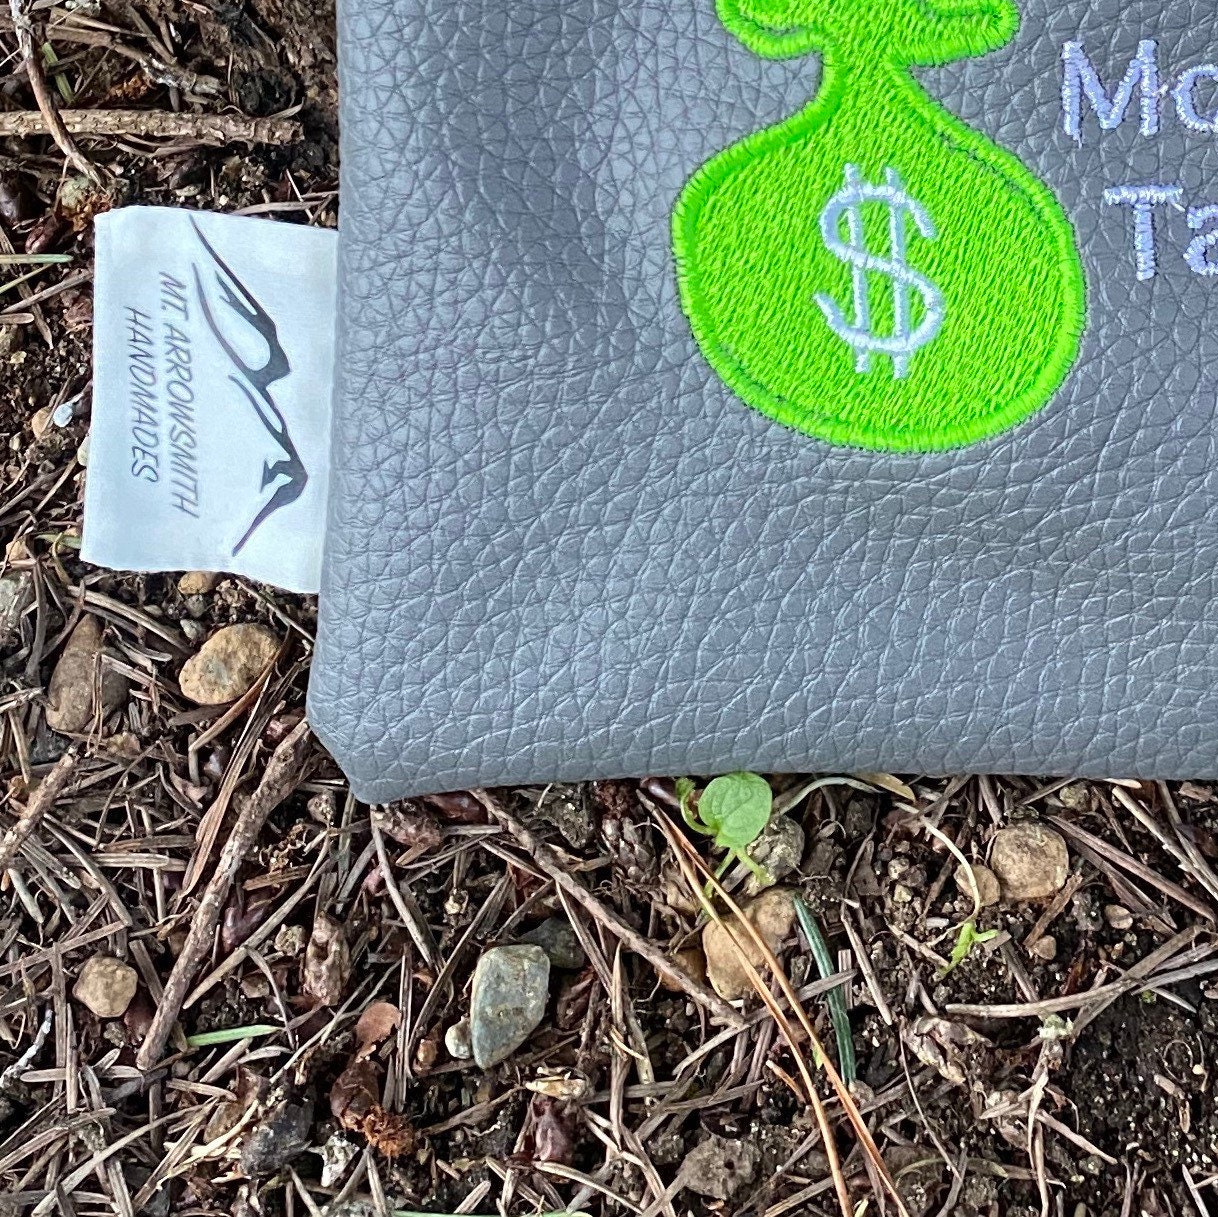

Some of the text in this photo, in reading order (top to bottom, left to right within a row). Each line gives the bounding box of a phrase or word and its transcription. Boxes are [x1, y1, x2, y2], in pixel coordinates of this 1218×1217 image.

[124, 305, 161, 484] HANDMADES
[159, 271, 200, 519] MT. ARROWSMITH
